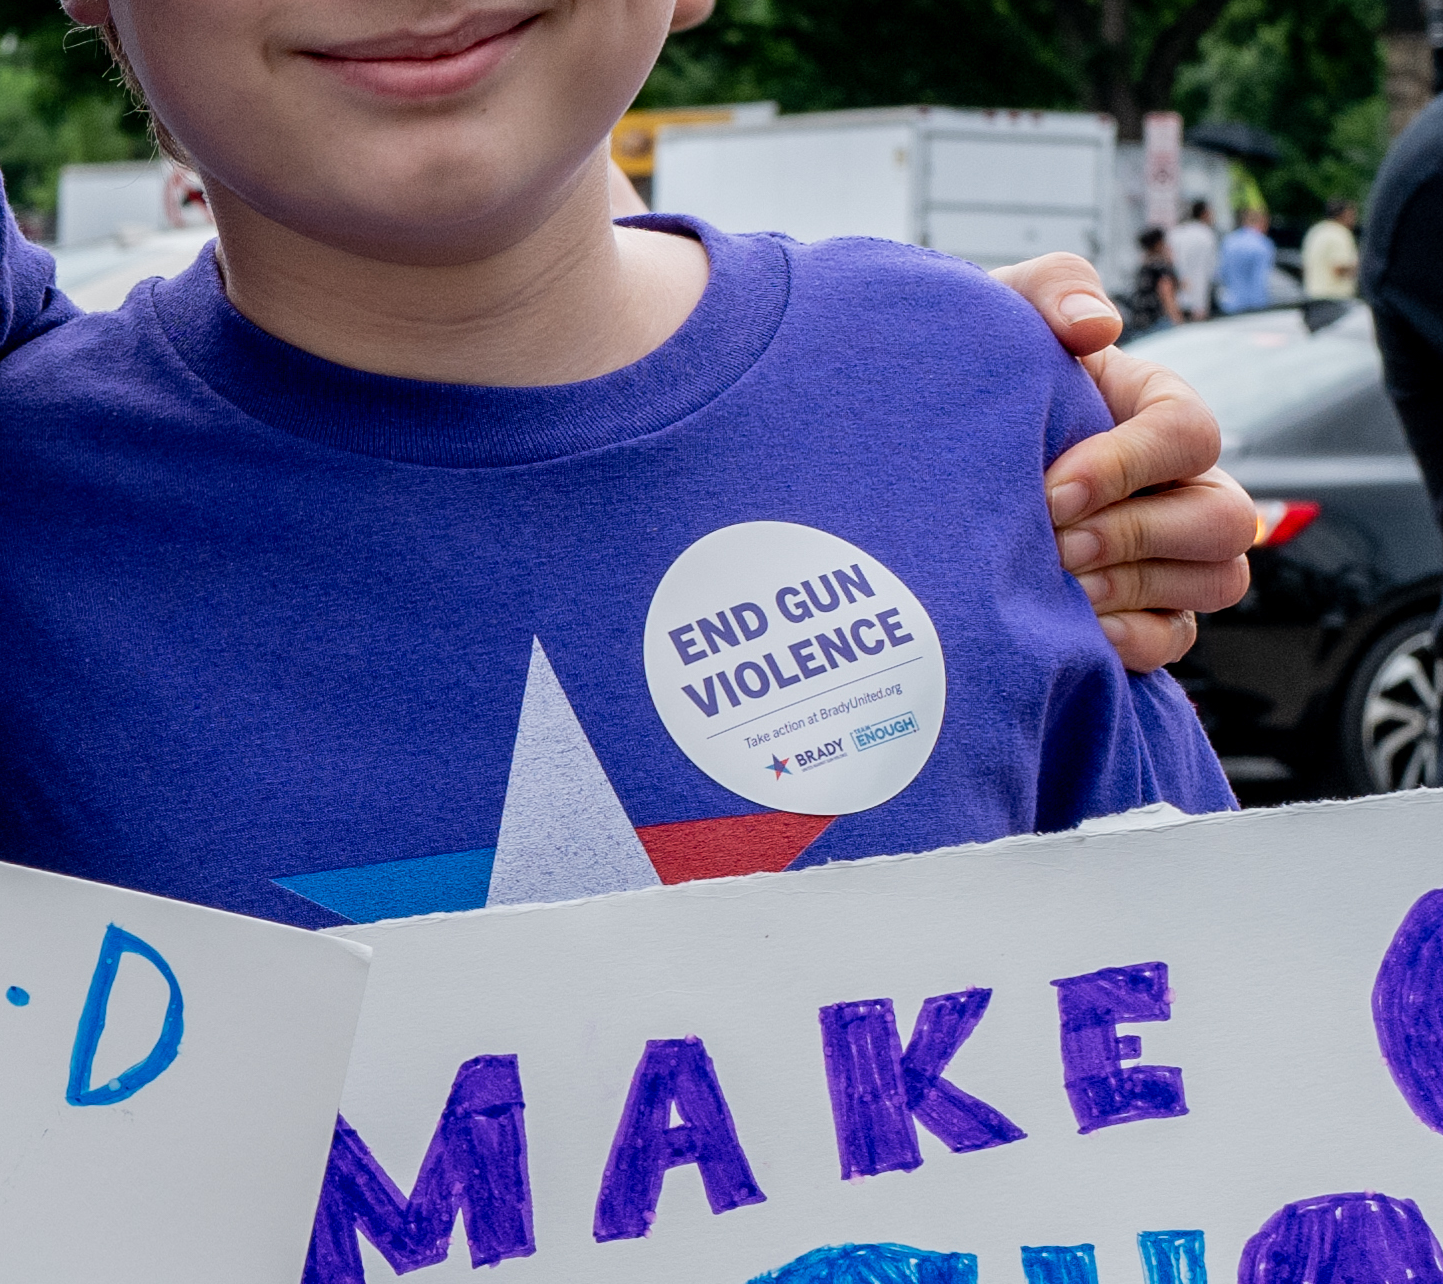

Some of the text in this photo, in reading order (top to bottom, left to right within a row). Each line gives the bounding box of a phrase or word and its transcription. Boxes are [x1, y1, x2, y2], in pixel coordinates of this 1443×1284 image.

[668, 563, 876, 666] END GUN
[681, 607, 914, 719] VIOLENCE
[744, 681, 903, 749] Take action at BradyUnited.org
[794, 737, 845, 768] BRADY
[856, 716, 916, 747] ENOUGH
